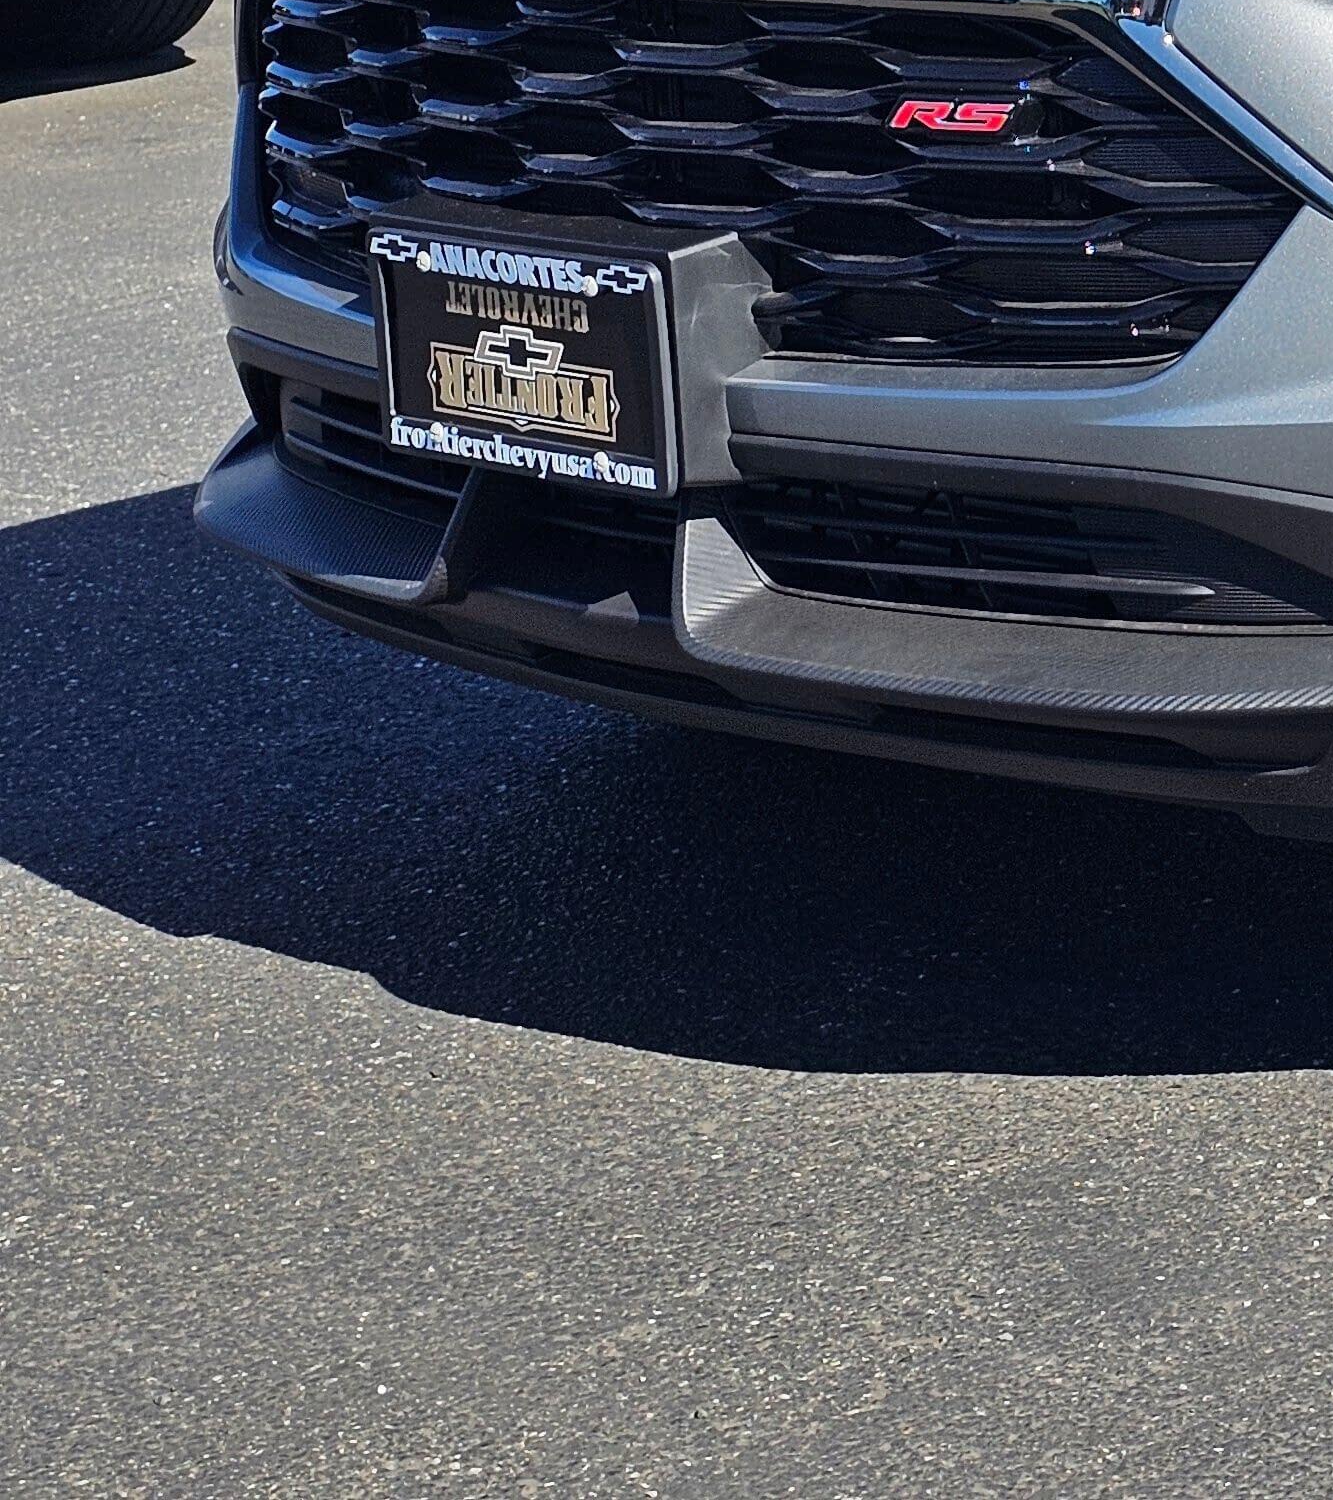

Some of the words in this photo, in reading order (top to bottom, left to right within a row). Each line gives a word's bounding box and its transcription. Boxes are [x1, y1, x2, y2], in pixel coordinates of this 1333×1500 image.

[890, 100, 1015, 132] RS
[429, 241, 584, 293] ANACORTES
[446, 280, 590, 334] CHEVROLET
[435, 350, 610, 434] FRONTIER
